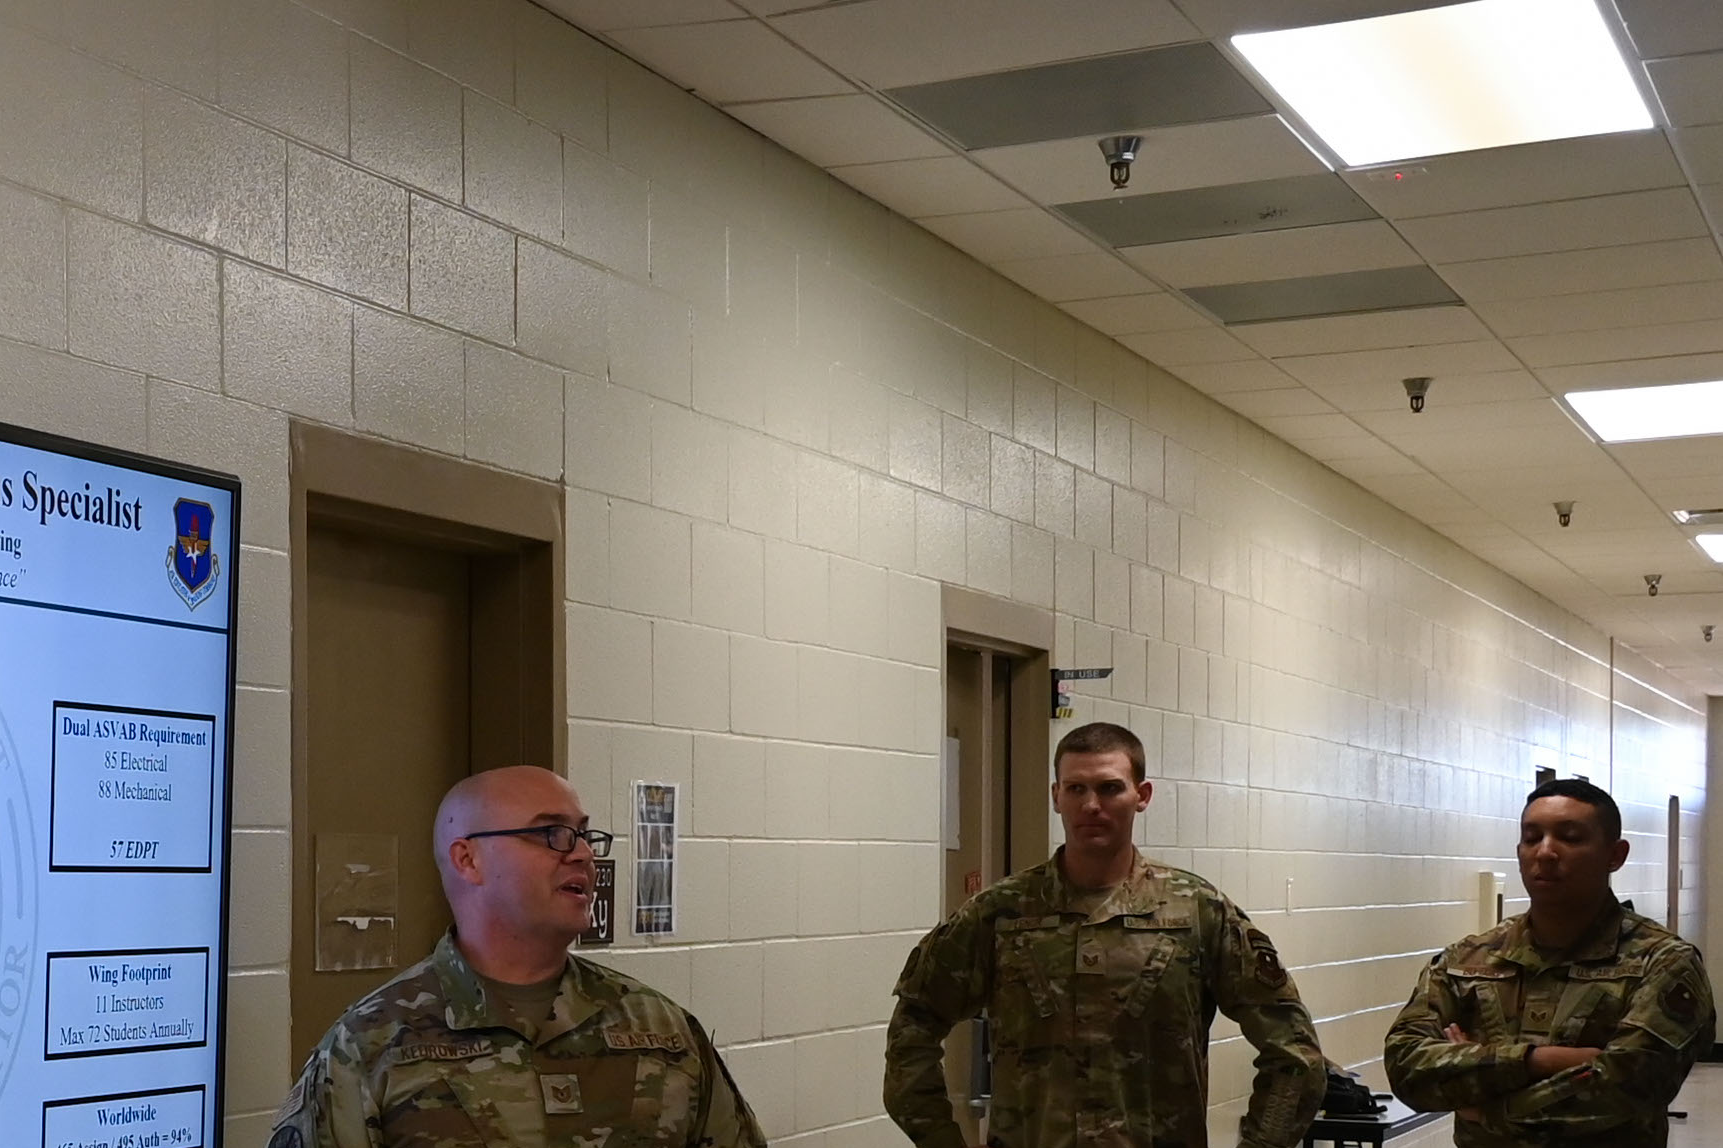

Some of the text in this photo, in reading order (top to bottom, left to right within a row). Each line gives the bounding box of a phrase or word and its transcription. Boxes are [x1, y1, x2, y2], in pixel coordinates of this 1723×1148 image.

[21, 470, 142, 532] Specialist
[1078, 670, 1100, 678] USE
[62, 716, 206, 748] Dual ASVAB Requirement
[104, 750, 168, 773] 85 Electrical
[98, 779, 172, 802] 88 Mechanical
[109, 840, 160, 859] 57 EDPT
[88, 962, 172, 988] Wing Footprint
[95, 994, 164, 1014] 11 Instructors
[59, 1018, 194, 1046] Max 72 Students Annually
[96, 1103, 157, 1126] Worldwide
[170, 1127, 192, 1145] 94%
